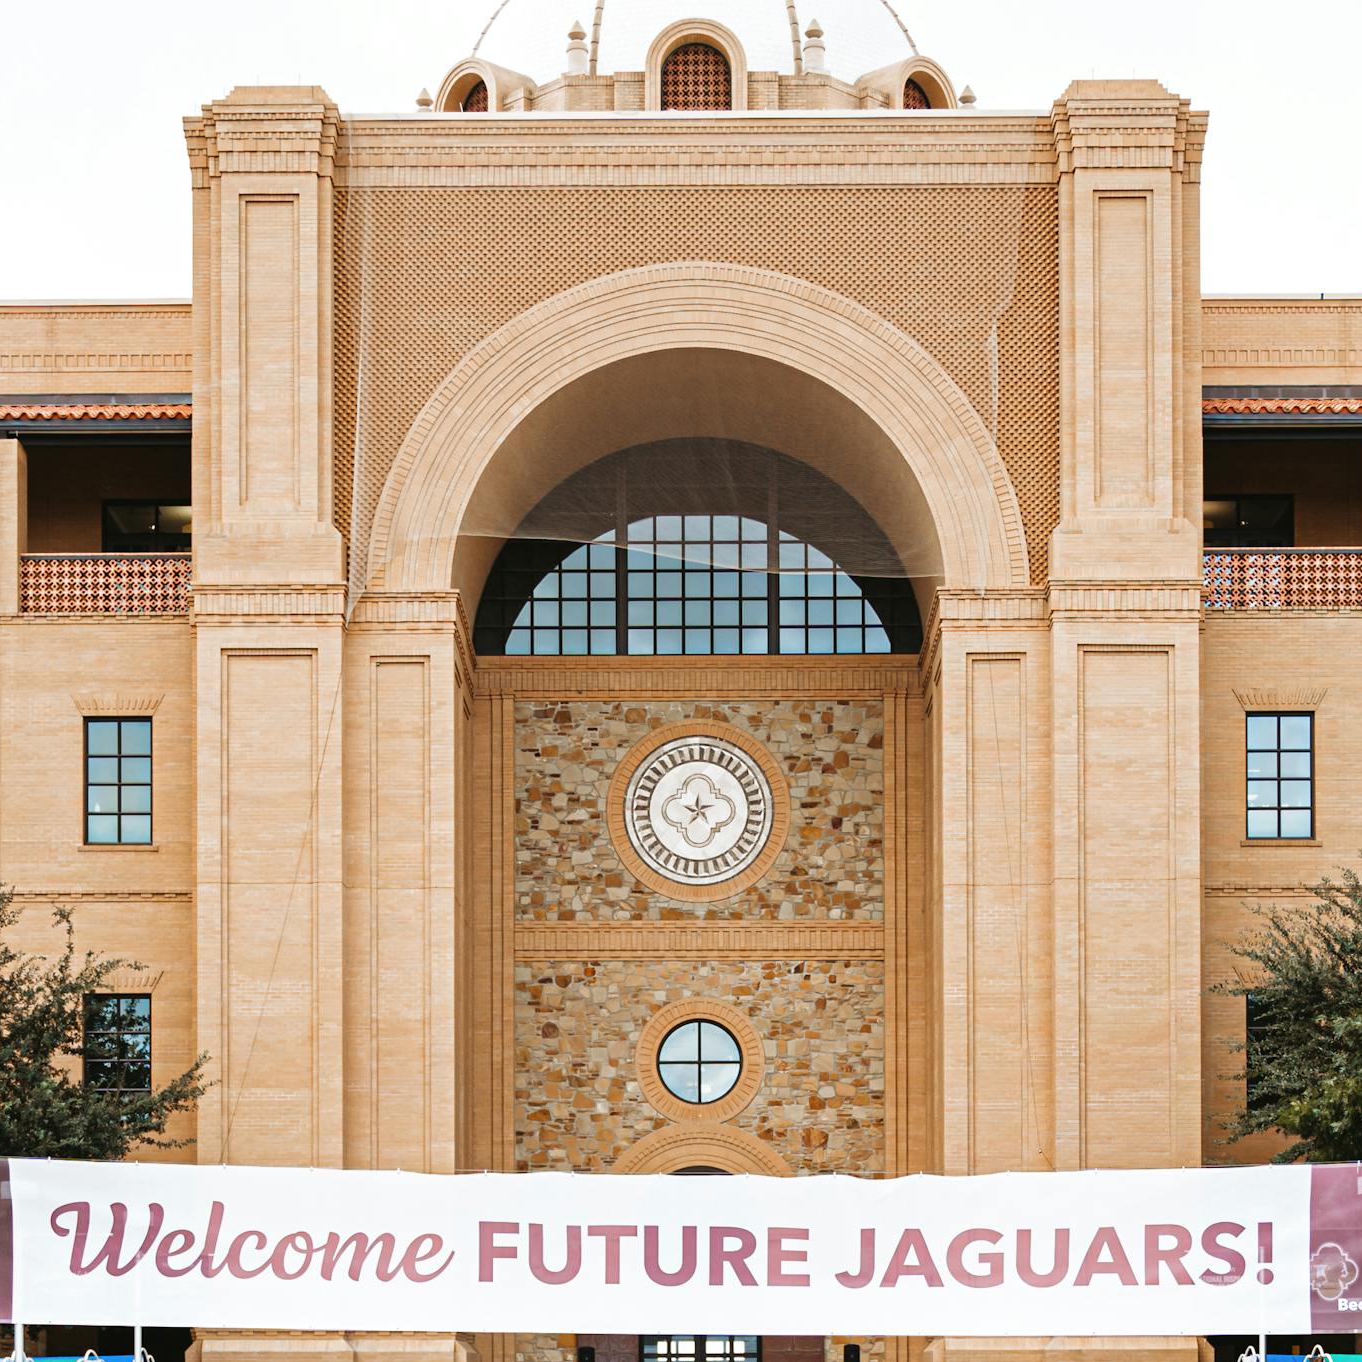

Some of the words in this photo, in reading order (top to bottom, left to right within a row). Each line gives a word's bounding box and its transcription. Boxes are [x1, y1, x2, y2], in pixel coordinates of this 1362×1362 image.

[50, 1200, 455, 1283] Welcome
[478, 1220, 811, 1286] FUTURE
[835, 1221, 1275, 1288] JAGUARS!
